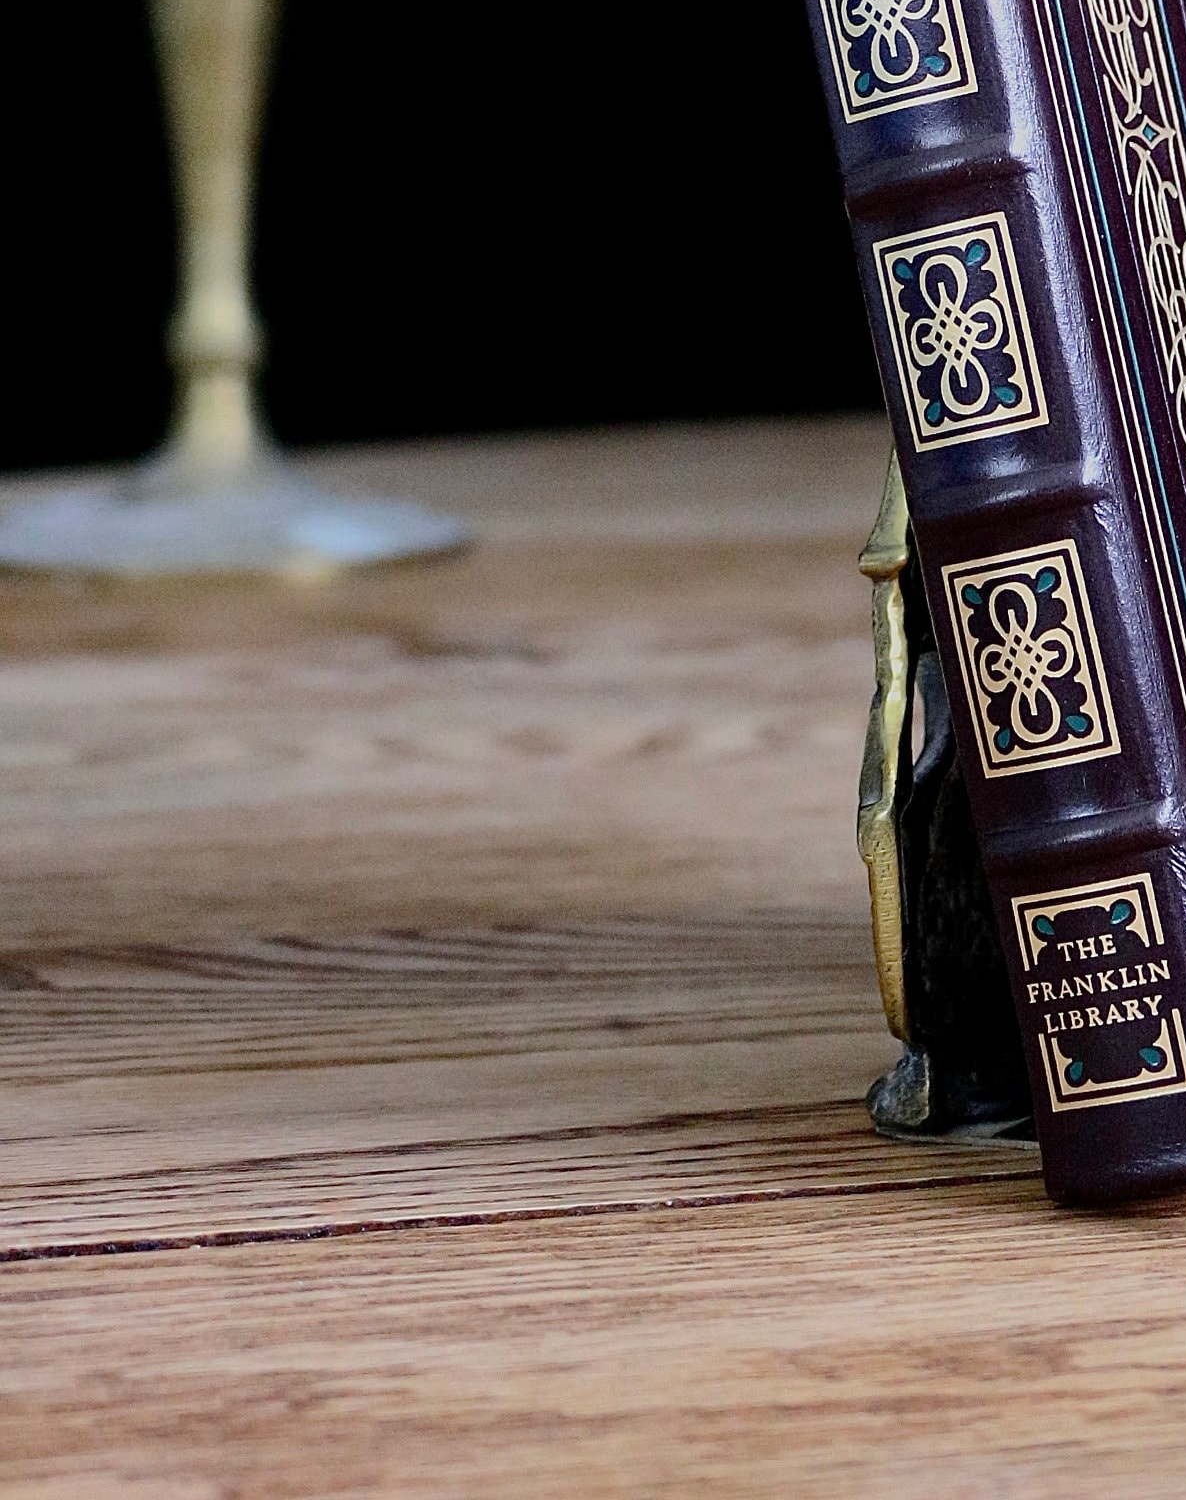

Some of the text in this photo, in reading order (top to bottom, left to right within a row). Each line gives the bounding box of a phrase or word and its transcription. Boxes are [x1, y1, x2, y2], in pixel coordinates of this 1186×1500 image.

[1057, 934, 1117, 961] THE
[1026, 960, 1171, 1003] FRANKLIN
[1044, 995, 1162, 1033] LIBRARY
